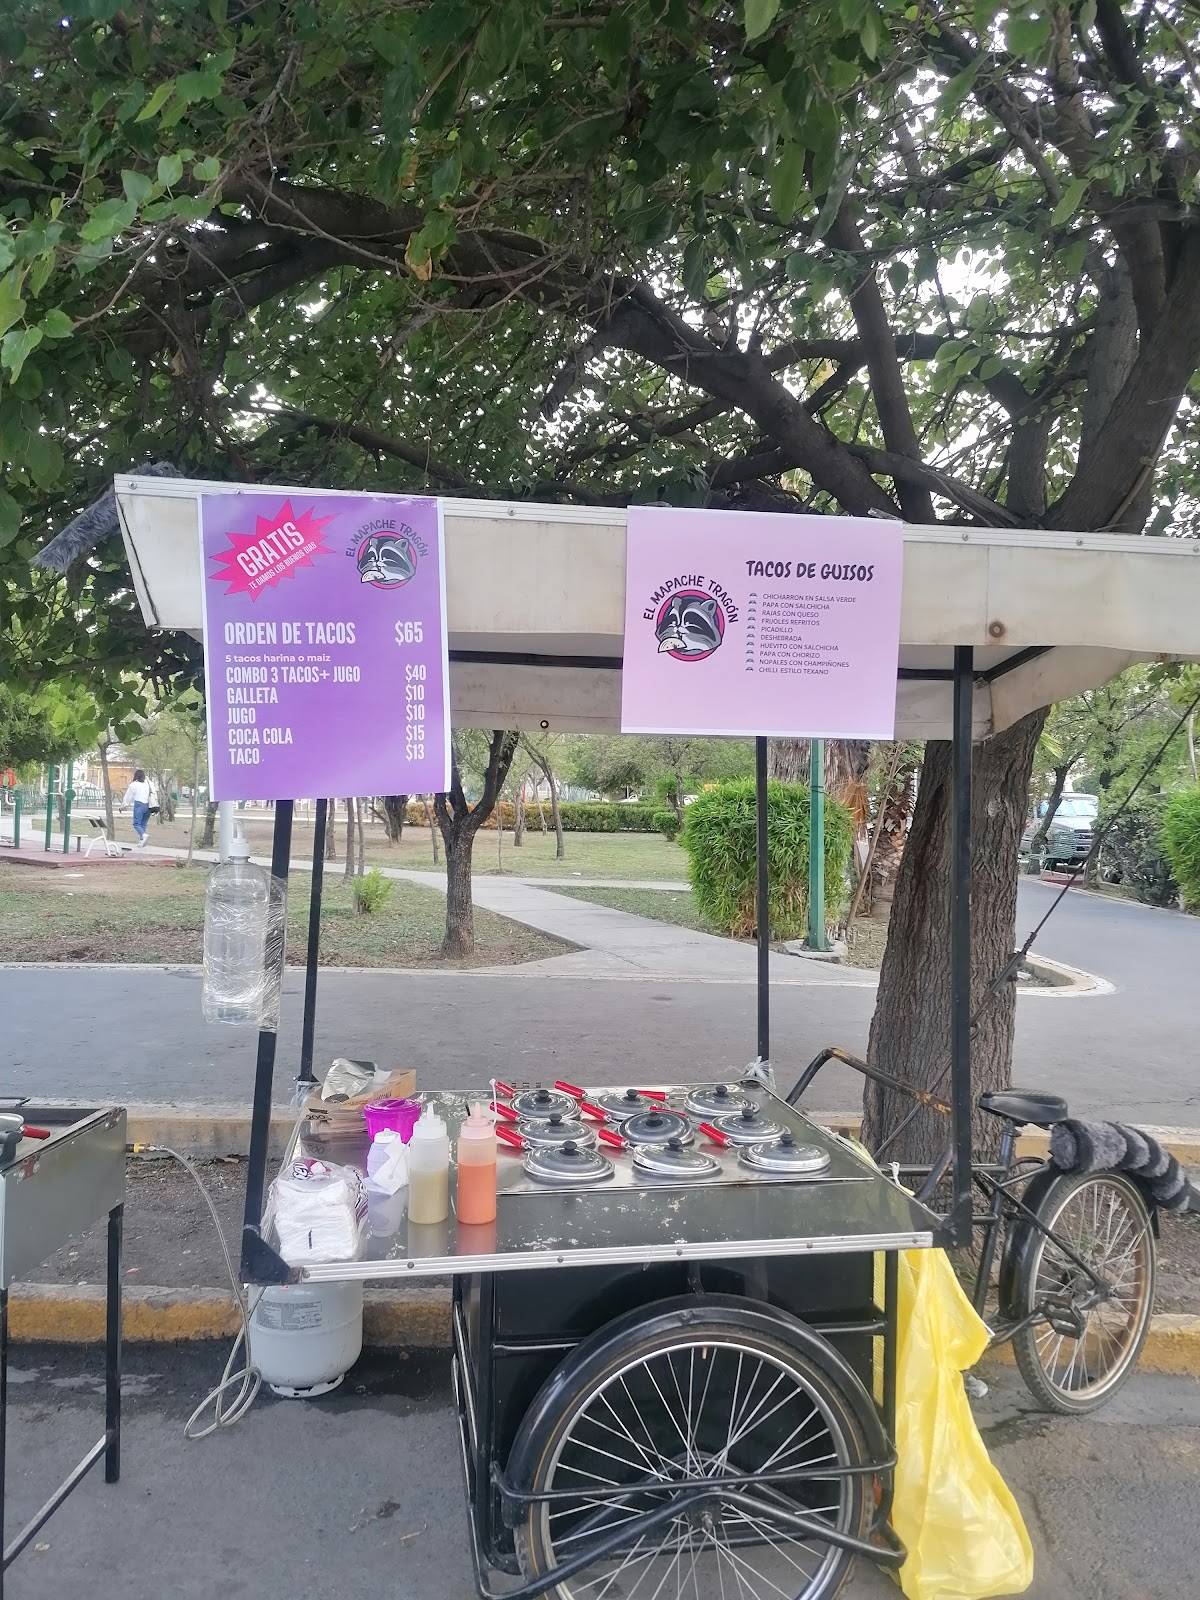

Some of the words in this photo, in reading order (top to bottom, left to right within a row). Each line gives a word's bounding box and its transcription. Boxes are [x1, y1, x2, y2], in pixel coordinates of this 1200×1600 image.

[350, 520, 396, 544] MAPACHE
[400, 522, 429, 557] TRAGÓN
[236, 521, 305, 577] GRATIS
[345, 547, 356, 558] EL
[248, 580, 258, 590] TE
[256, 568, 276, 586] DAMOS
[273, 562, 286, 574] LOS
[283, 550, 305, 569] BUENOS
[746, 560, 792, 578] TACOS
[796, 562, 816, 578] DE
[820, 564, 874, 582] GUISOS
[643, 608, 656, 620] EL
[650, 574, 704, 604] MAPACHE
[708, 580, 739, 624] TRAGÓN
[224, 622, 276, 644] ORDEN
[282, 622, 302, 644] DE
[306, 622, 356, 644] TACOS
[394, 620, 424, 646] $65
[225, 654, 232, 662] 5
[234, 654, 262, 662] tacos
[264, 654, 296, 662] harina
[307, 654, 332, 662] maiz
[226, 667, 268, 684] COMBO
[271, 667, 278, 684] 3
[281, 666, 330, 683] TACOS+
[333, 666, 360, 682] JUGO
[406, 664, 426, 682] $40
[227, 687, 278, 704] GALLETA
[406, 684, 424, 702] $10
[228, 708, 256, 724] JUGO
[406, 704, 425, 722] $10
[228, 728, 260, 744] COCA
[263, 728, 293, 744] COLA
[406, 724, 424, 743] $15
[229, 748, 260, 764] TACO
[406, 744, 424, 762] $13
